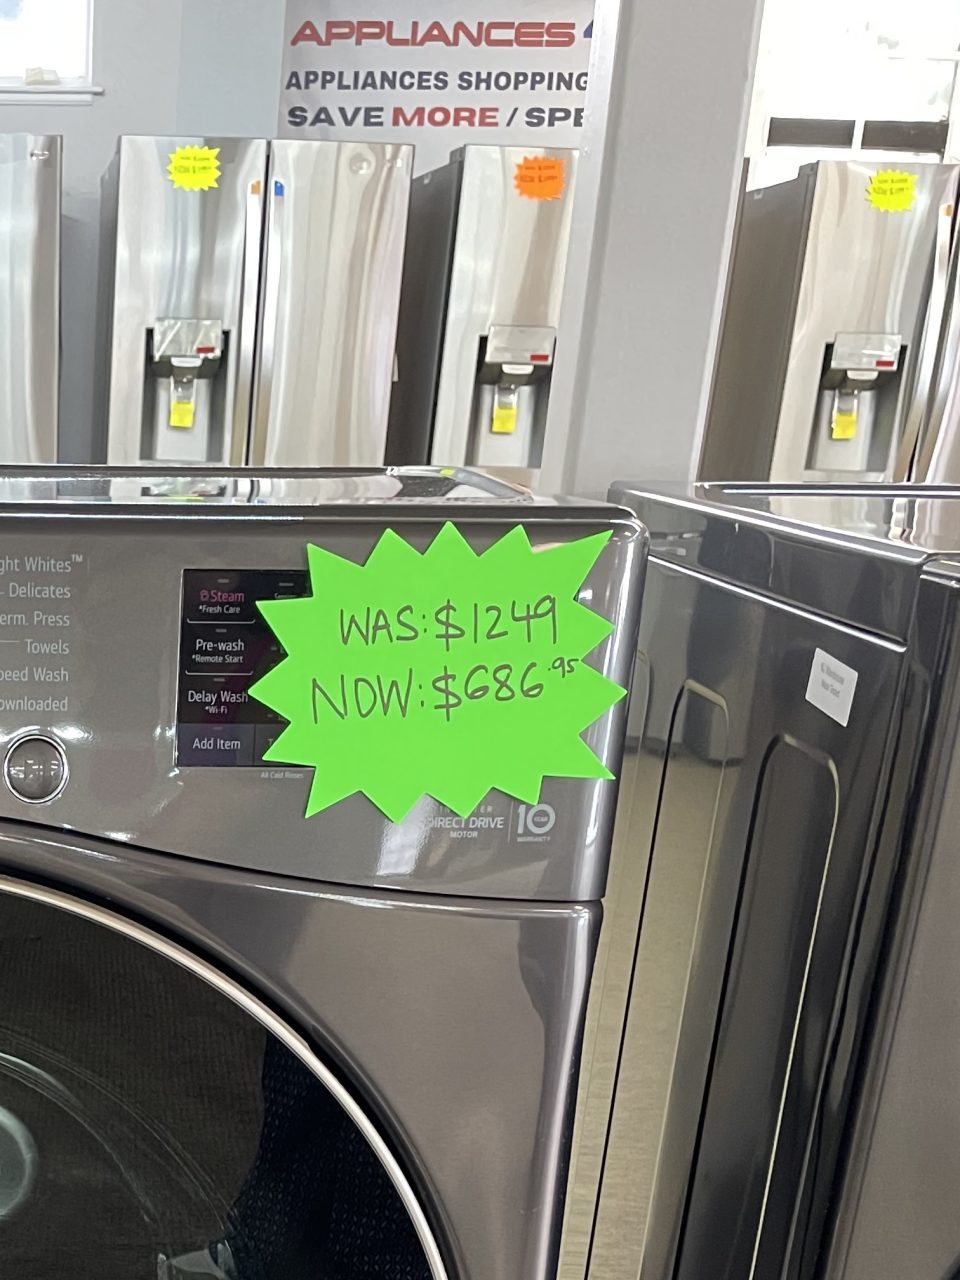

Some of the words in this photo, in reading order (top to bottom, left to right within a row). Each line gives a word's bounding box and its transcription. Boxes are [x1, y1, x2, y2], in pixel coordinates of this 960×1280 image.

[290, 20, 576, 47] APPLIANCES
[285, 71, 449, 91] APPLIANCES
[457, 71, 588, 91] SHOPPING
[288, 106, 384, 127] SAVE
[392, 107, 499, 127] MORE
[506, 107, 519, 127] /
[9, 583, 71, 599] Delicates
[210, 589, 245, 602] Steam
[223, 604, 241, 614] Care
[33, 611, 71, 626] Press
[25, 639, 70, 655] Towels
[196, 638, 245, 651] Pre-wash
[225, 654, 244, 663] Start
[33, 667, 69, 683] Wash
[188, 690, 218, 706] Delay
[220, 690, 249, 703] Wash
[192, 737, 214, 750] Add
[217, 738, 241, 750] Item
[469, 817, 504, 829] DRIVE
[517, 803, 556, 834] 10
[450, 830, 478, 838] MOTOR
